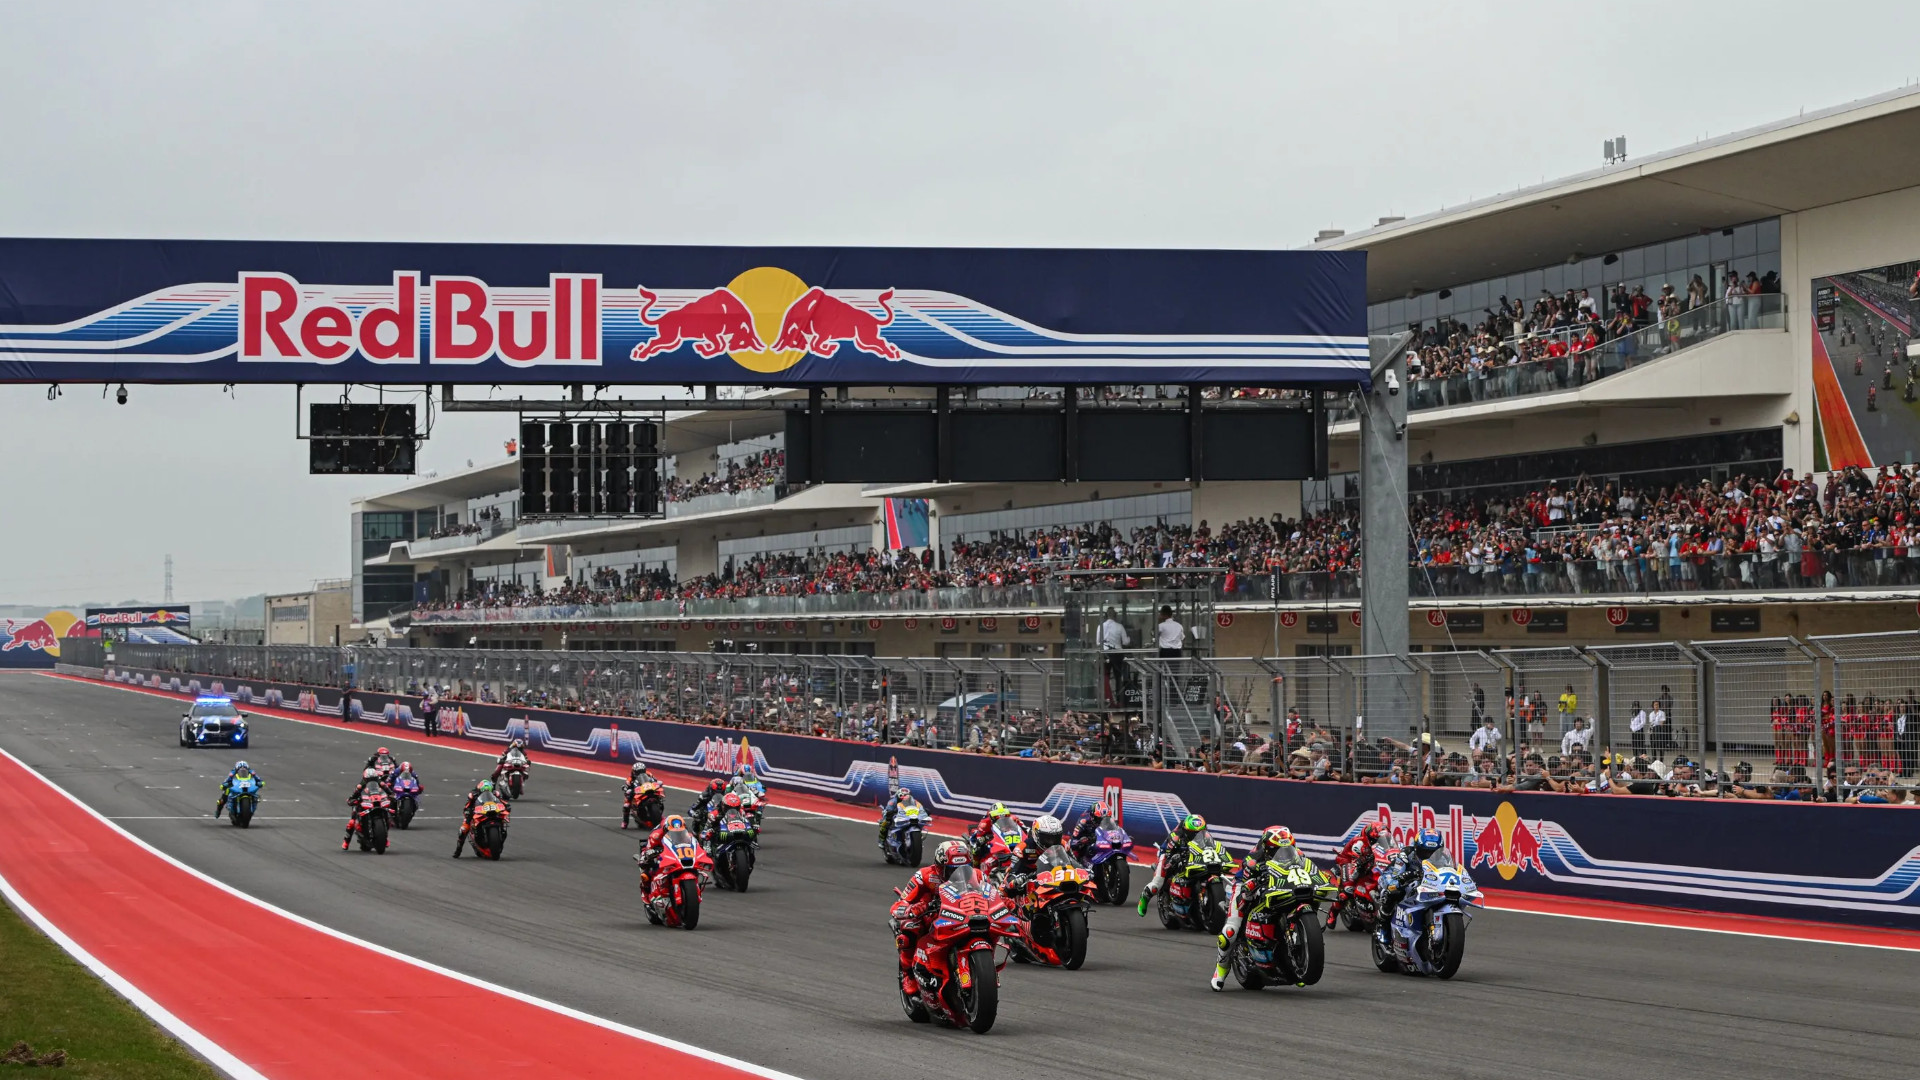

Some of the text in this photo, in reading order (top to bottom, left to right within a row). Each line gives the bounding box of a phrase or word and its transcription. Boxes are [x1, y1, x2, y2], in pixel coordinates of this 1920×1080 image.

[243, 275, 598, 361] Red Bull
[99, 611, 142, 624] Red Bull
[1220, 614, 1231, 625] 25
[1284, 613, 1294, 624] 26
[1431, 611, 1443, 623] 28
[1516, 608, 1528, 622] 29
[1611, 608, 1623, 622] 30
[871, 618, 880, 628] 19
[945, 617, 954, 627] 21
[985, 617, 995, 627] 22
[1028, 617, 1038, 627] 23
[705, 736, 732, 774] Red Bull
[1004, 835, 1021, 845] 36
[676, 847, 695, 859] 10
[1202, 848, 1222, 863] 21
[1054, 869, 1075, 882] 37
[1287, 868, 1312, 886] 49
[1439, 872, 1461, 886] 73
[959, 897, 989, 912] 93
[941, 909, 964, 921] Lenovo
[991, 908, 1009, 920] Lenovo
